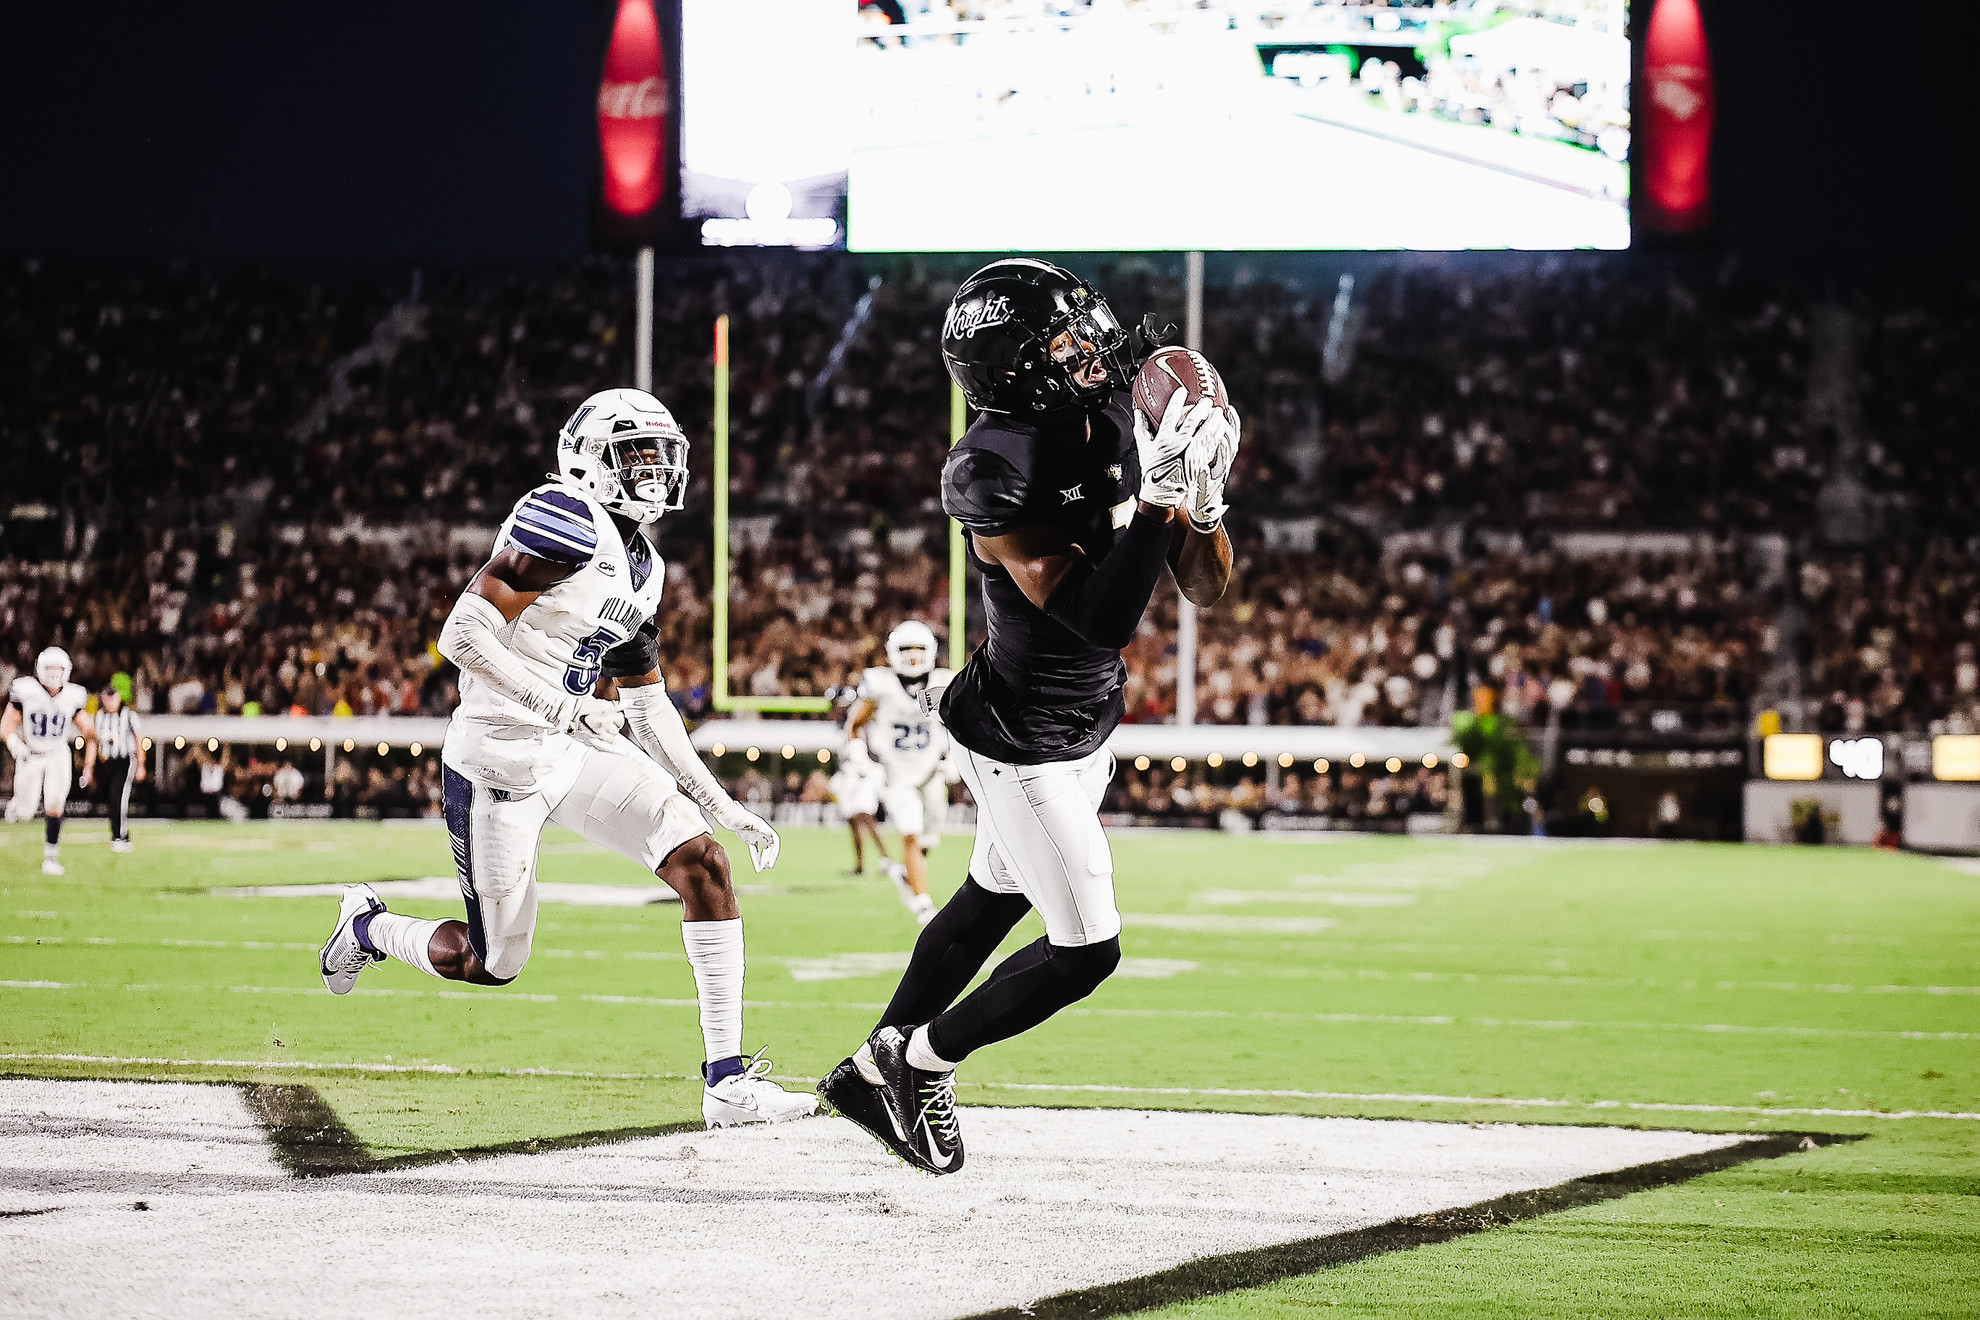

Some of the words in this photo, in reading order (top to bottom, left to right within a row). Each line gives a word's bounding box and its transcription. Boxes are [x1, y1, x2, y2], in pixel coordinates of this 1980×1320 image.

[944, 297, 1013, 340] Knights
[1059, 483, 1085, 505] XII
[562, 625, 623, 696] 5
[30, 710, 66, 737] 99
[893, 723, 930, 750] 25
